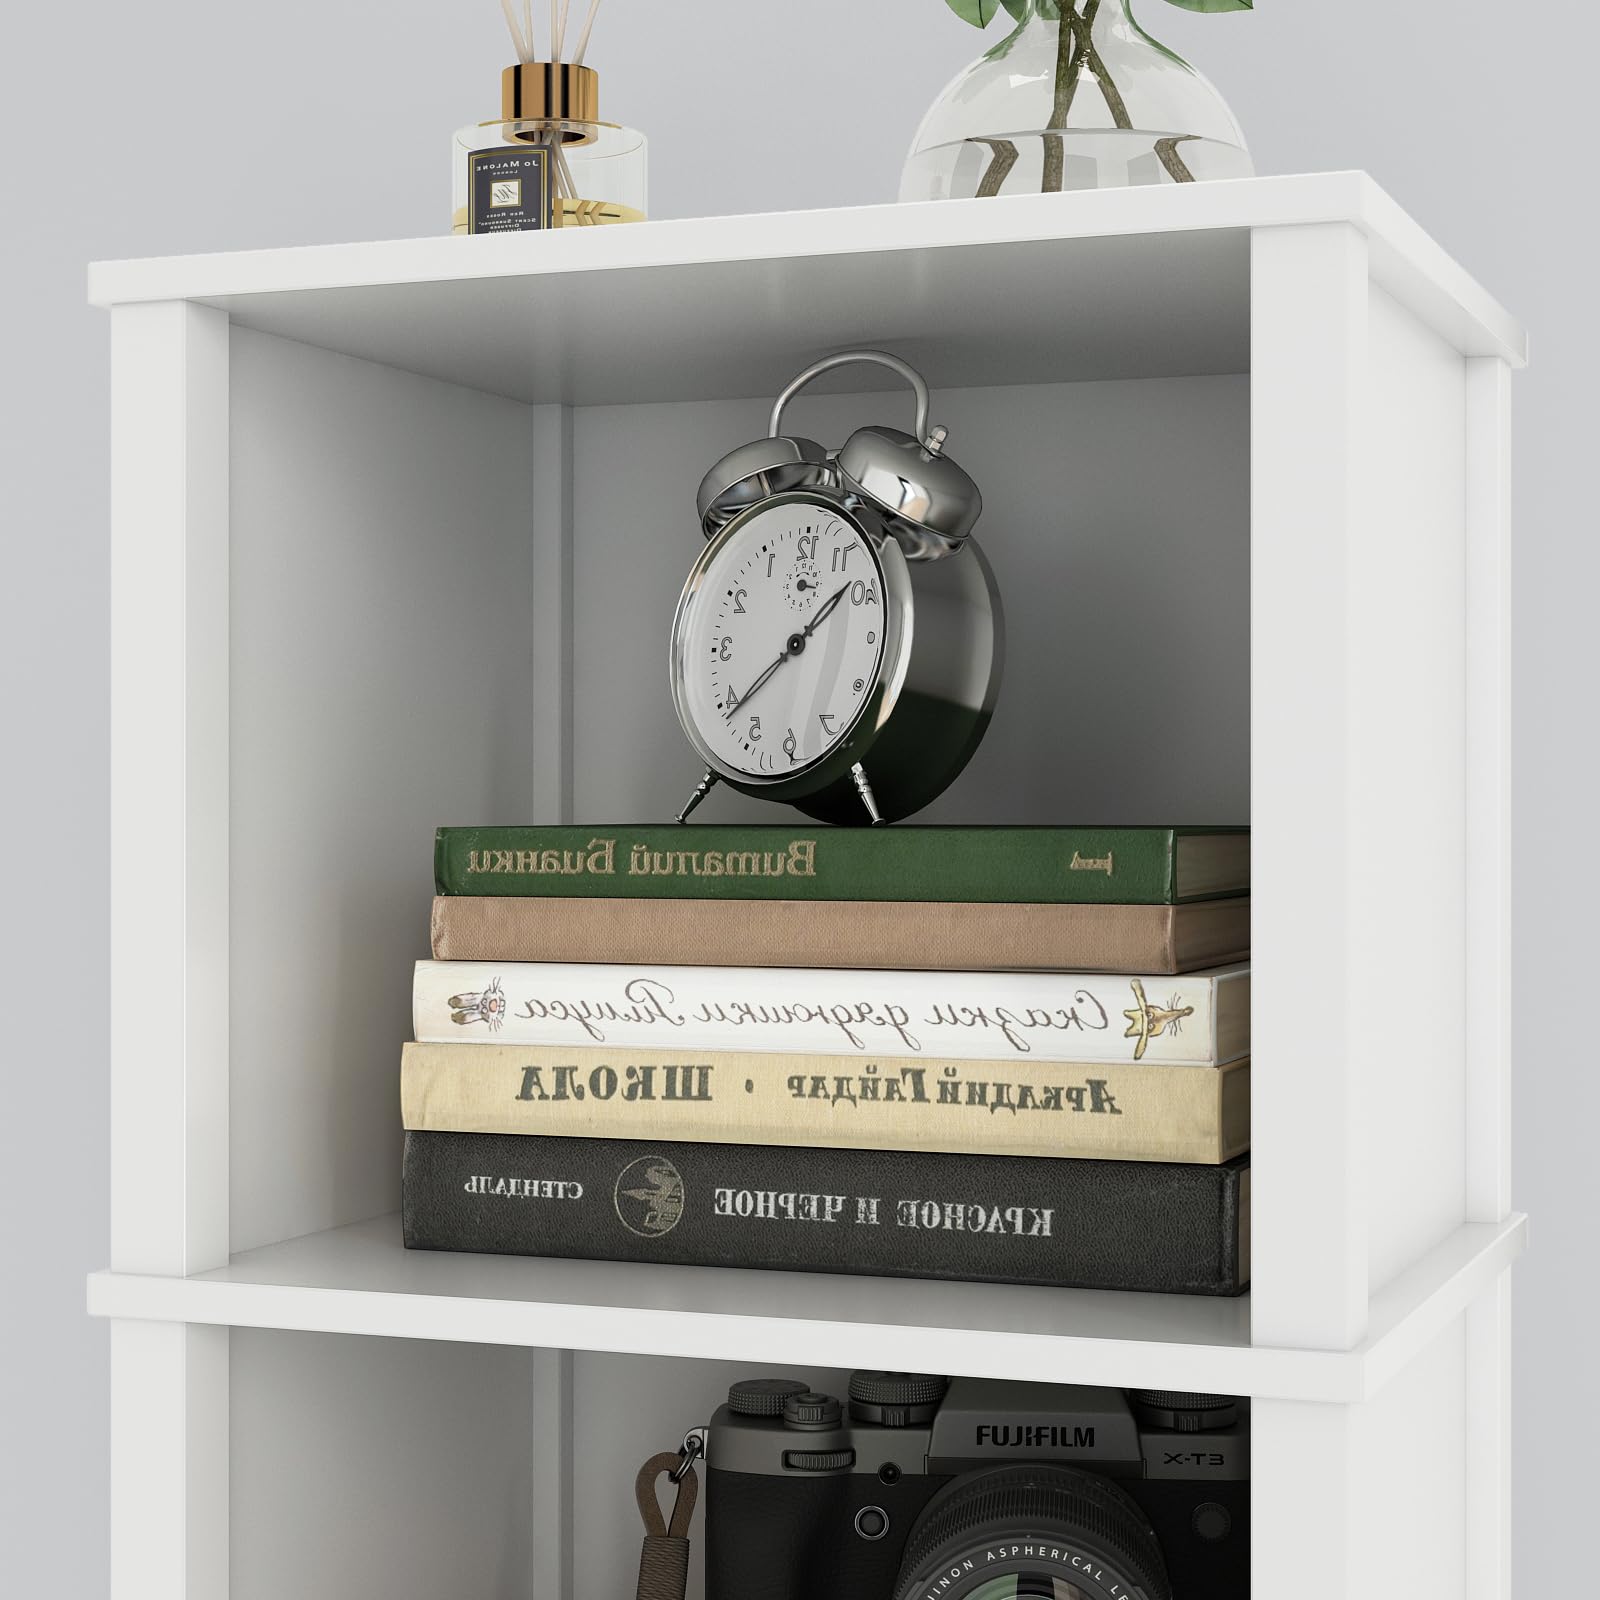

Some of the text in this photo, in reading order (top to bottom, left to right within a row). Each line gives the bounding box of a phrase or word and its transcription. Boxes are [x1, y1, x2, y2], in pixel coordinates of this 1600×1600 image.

[976, 1425, 1095, 1447] FUJIFILM
[1163, 1452, 1225, 1466] X-T3
[987, 1546, 1103, 1580] ASPHERICAL
